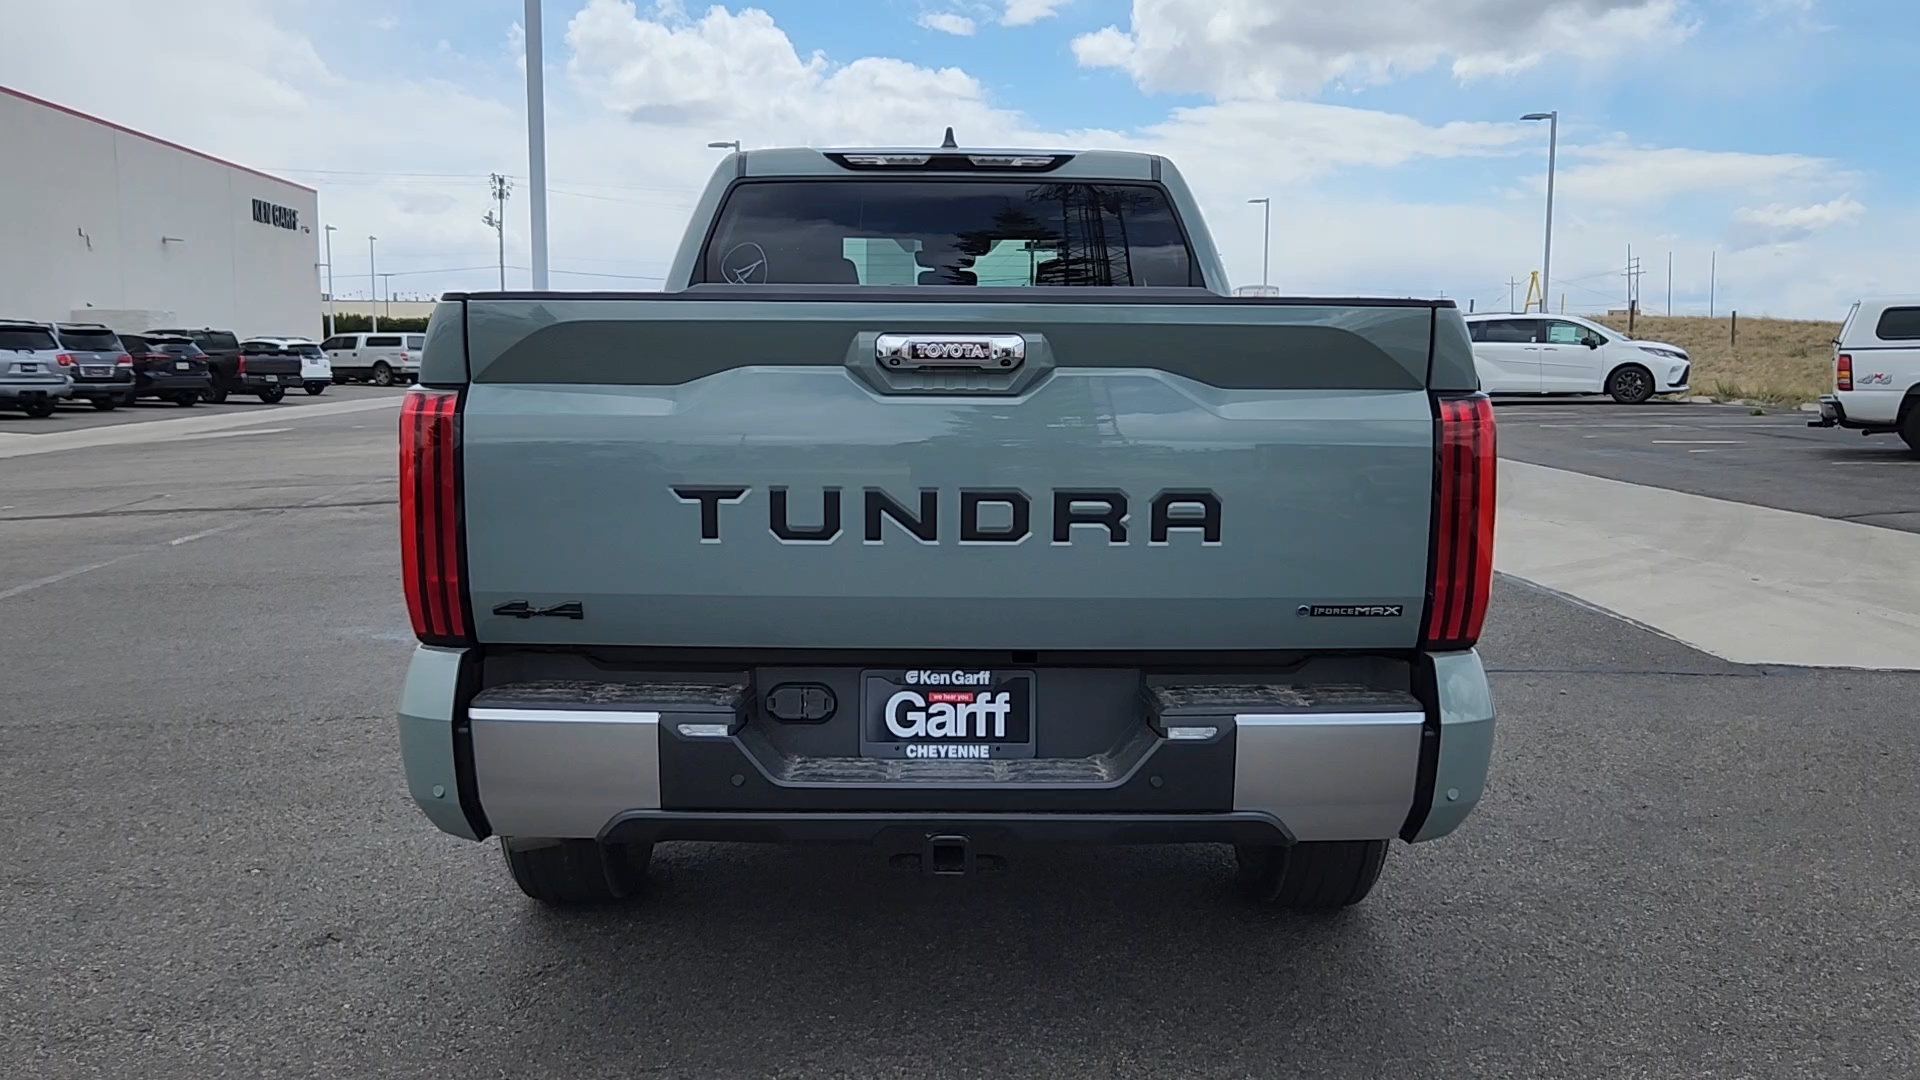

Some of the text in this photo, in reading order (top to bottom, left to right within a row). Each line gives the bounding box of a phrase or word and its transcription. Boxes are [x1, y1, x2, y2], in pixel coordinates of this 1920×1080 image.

[916, 343, 985, 358] TOYOTA
[667, 484, 1223, 547] TUNDRA
[920, 670, 991, 685] Ken Garff
[885, 690, 1011, 738] Garff
[906, 745, 990, 759] CHEYENNE
